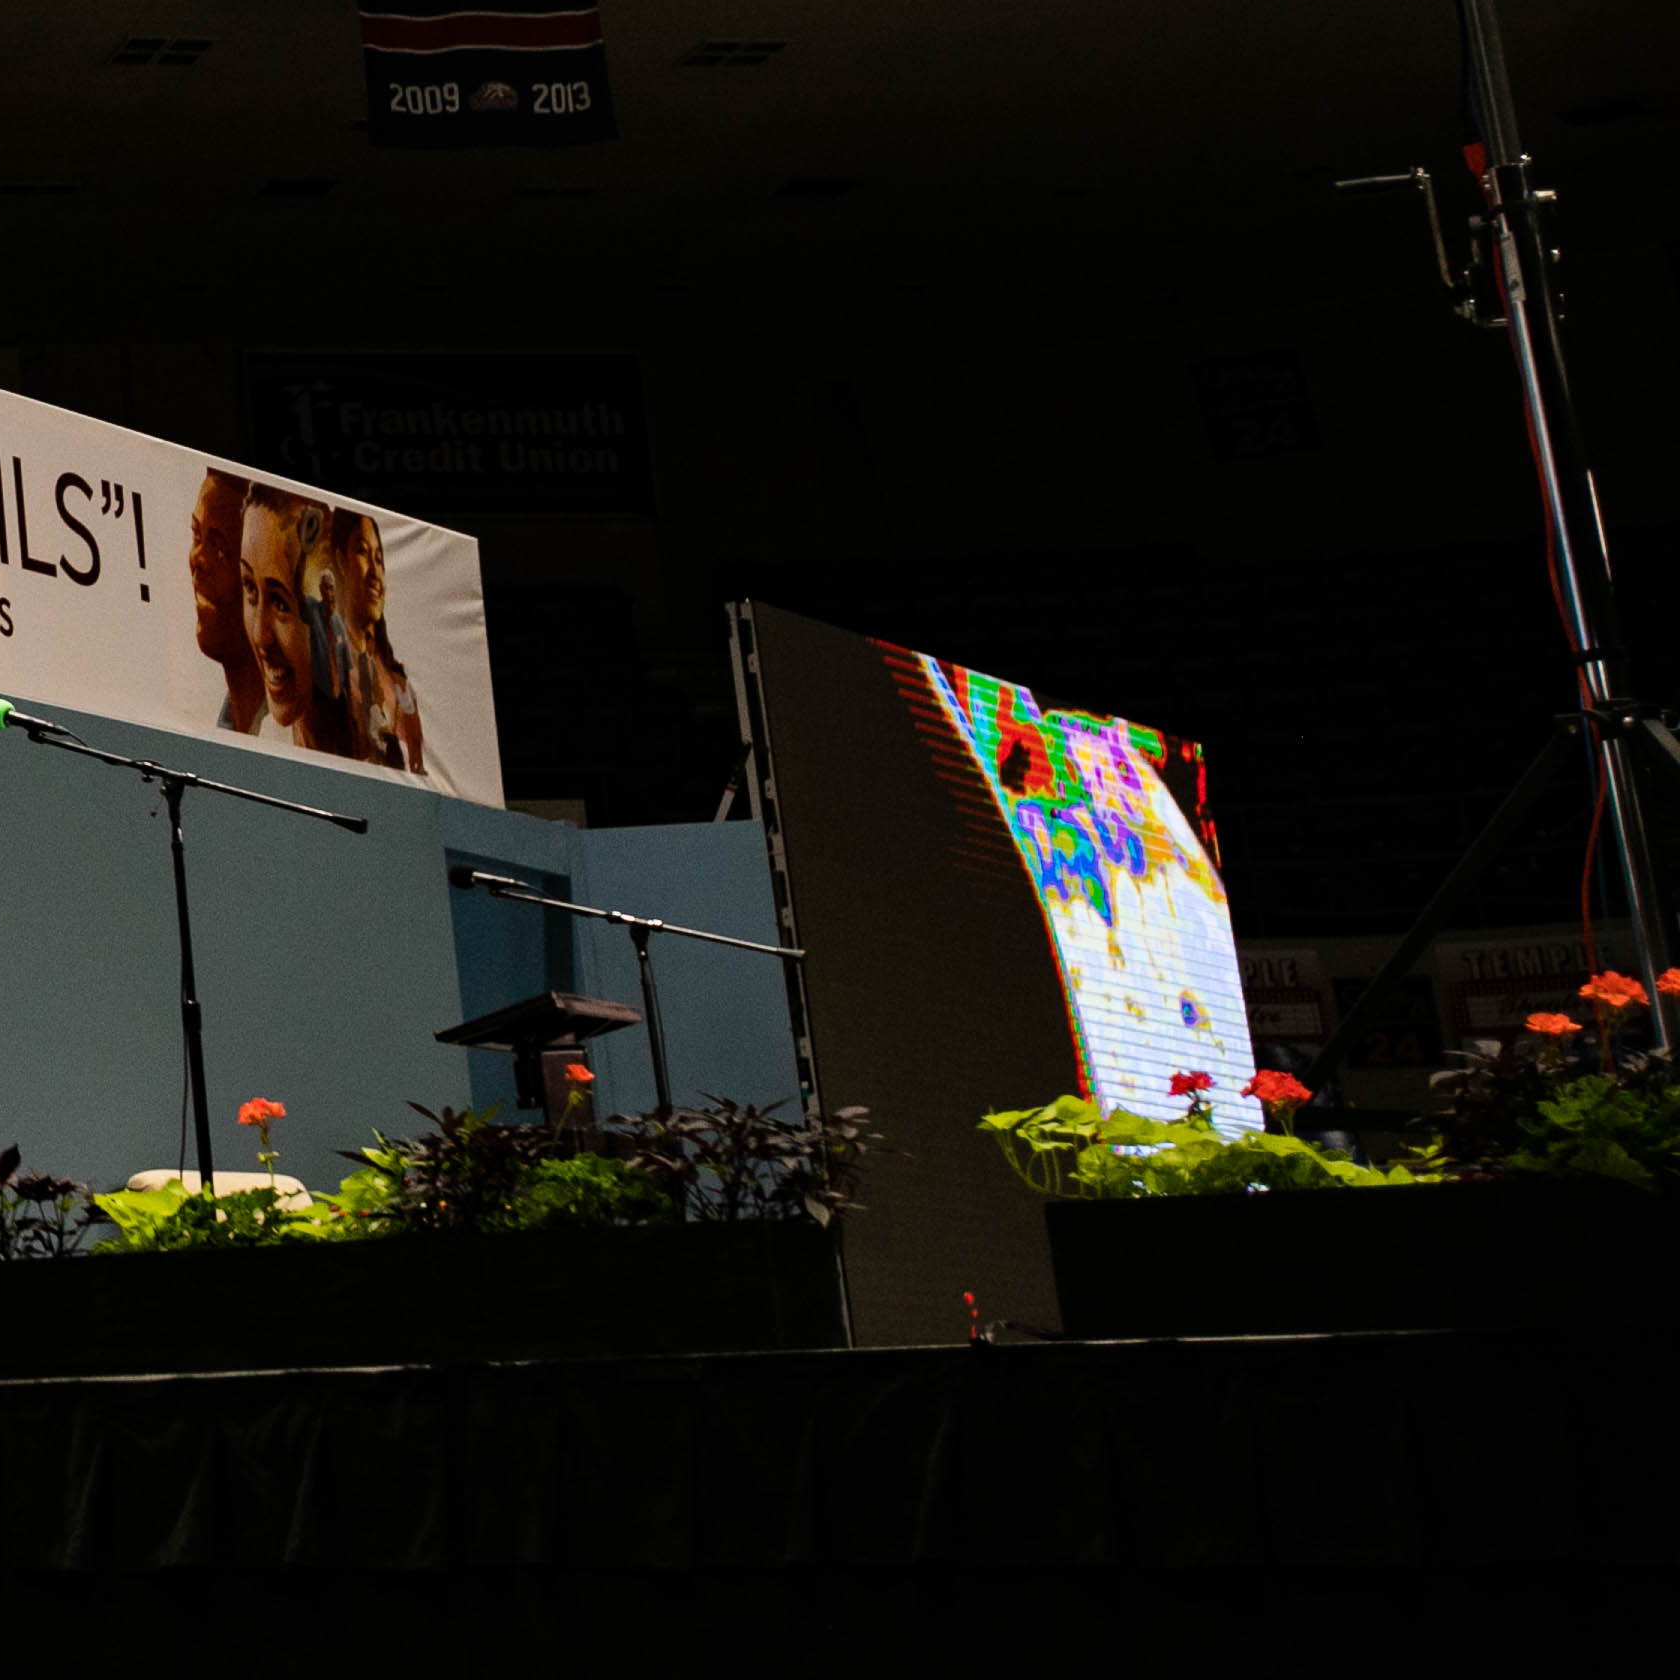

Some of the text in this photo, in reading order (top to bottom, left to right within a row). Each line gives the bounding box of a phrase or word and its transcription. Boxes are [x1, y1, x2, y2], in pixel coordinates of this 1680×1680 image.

[389, 81, 591, 115] 2009 2013
[338, 401, 624, 437] Frankenmuth
[353, 439, 621, 474] Credit Union
